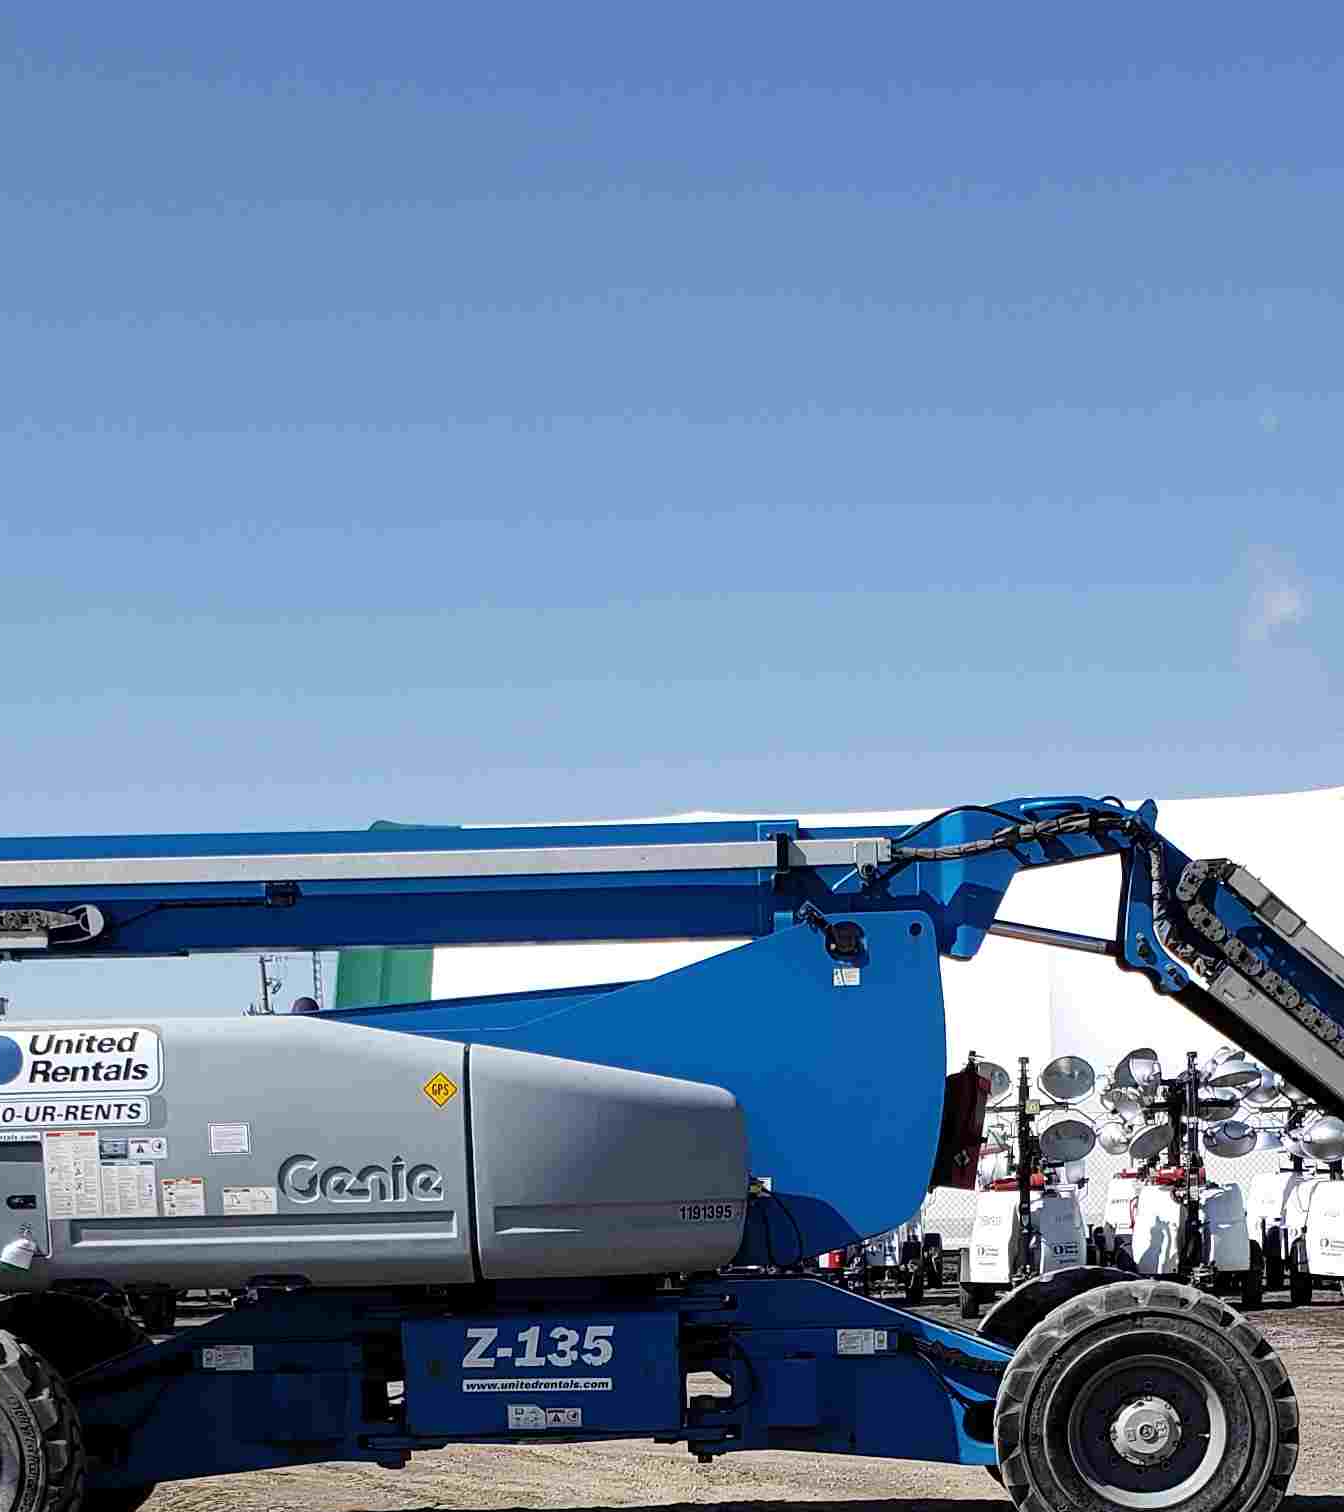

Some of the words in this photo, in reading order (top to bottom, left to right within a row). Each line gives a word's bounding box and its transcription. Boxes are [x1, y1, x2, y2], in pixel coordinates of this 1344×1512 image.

[30, 1031, 139, 1056] United
[29, 1058, 149, 1083] Rentals
[431, 1083, 449, 1096] GPS
[278, 1154, 445, 1203] Genie
[680, 1205, 732, 1220] 1191395
[463, 1326, 614, 1368] Z-135
[465, 1378, 609, 1393] www.unitedrentals.com
